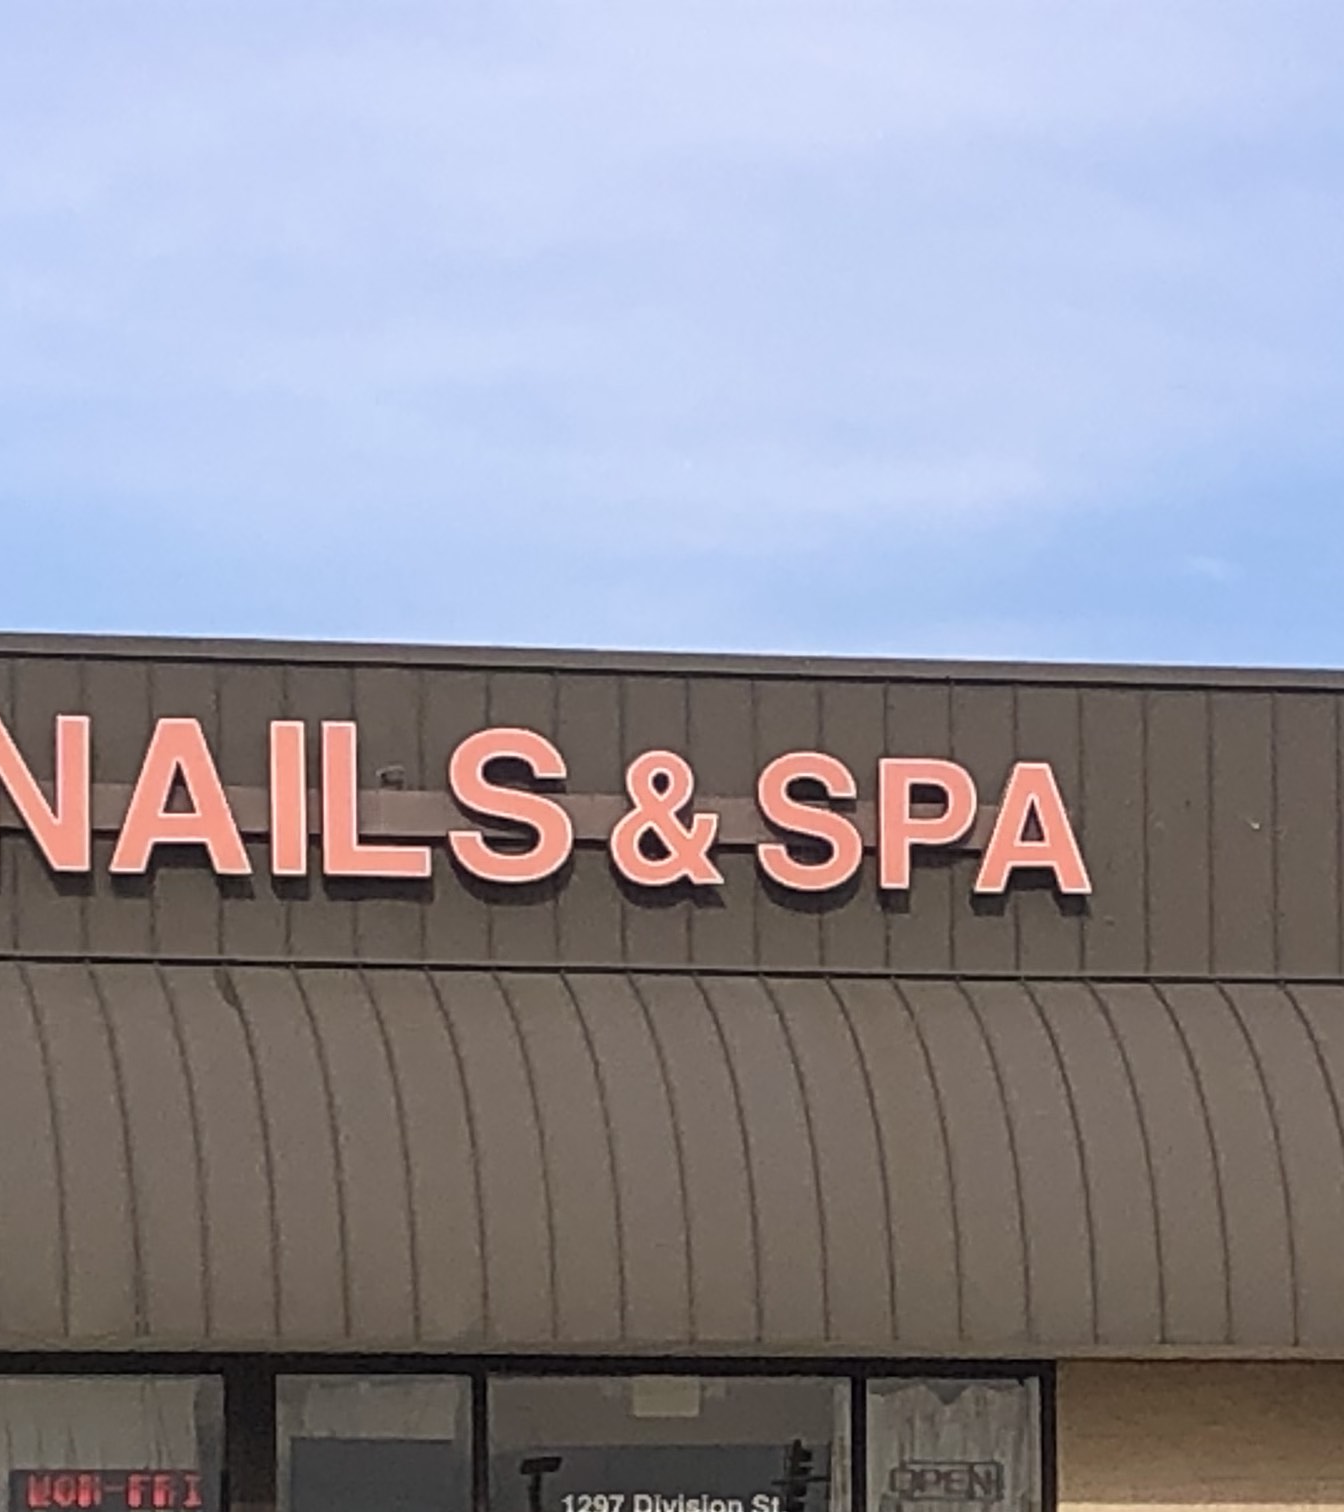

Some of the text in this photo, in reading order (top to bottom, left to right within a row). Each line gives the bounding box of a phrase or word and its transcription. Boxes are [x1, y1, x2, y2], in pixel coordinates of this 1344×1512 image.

[610, 749, 724, 887] &
[757, 751, 1092, 895] SPA
[889, 1464, 993, 1500] OPEN
